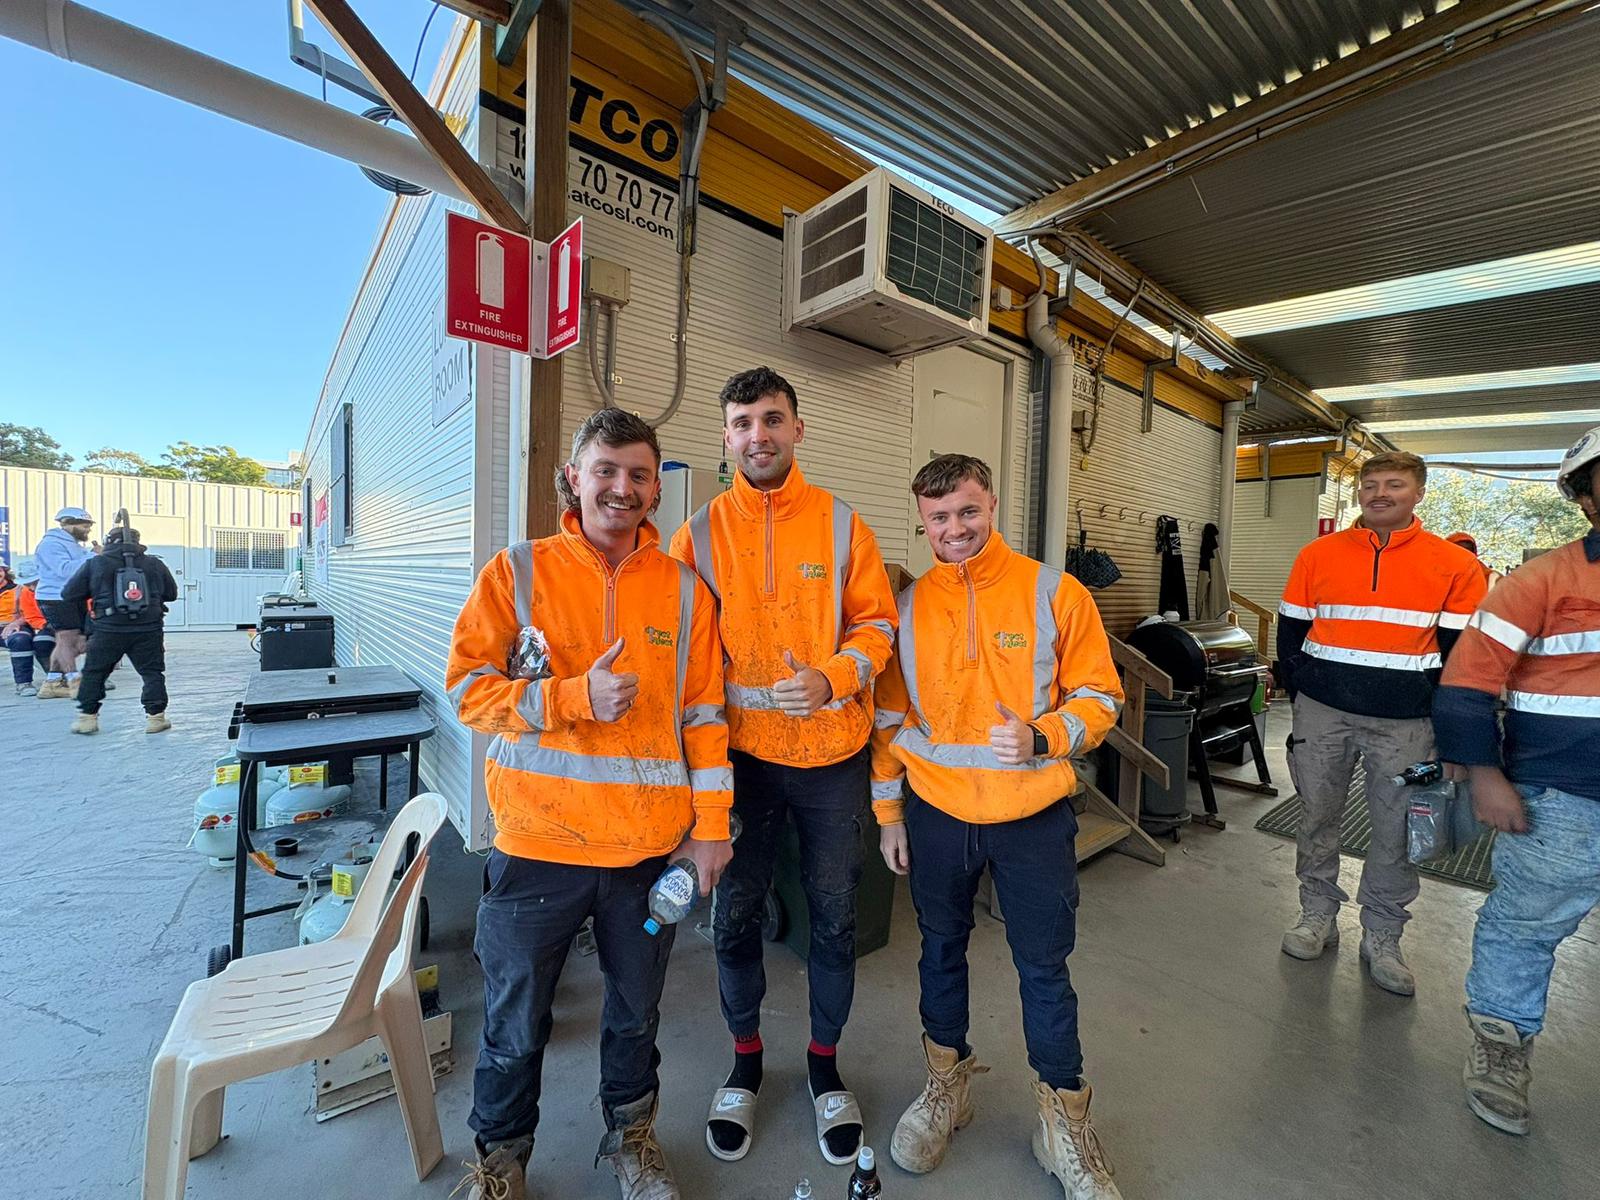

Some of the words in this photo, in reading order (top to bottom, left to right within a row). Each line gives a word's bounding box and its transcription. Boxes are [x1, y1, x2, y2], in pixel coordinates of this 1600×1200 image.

[579, 156, 607, 195] 70
[616, 172, 642, 210] 70
[649, 187, 674, 221] 77
[931, 195, 955, 215] TECO
[479, 309, 501, 323] FIRE
[557, 315, 568, 329] FIRE
[454, 319, 523, 344] EXTINGUISHER
[549, 326, 576, 348] EXTINGUISHER
[435, 347, 464, 404] ROOM
[721, 1092, 744, 1105] NIKE
[827, 1095, 848, 1109] NIKE
